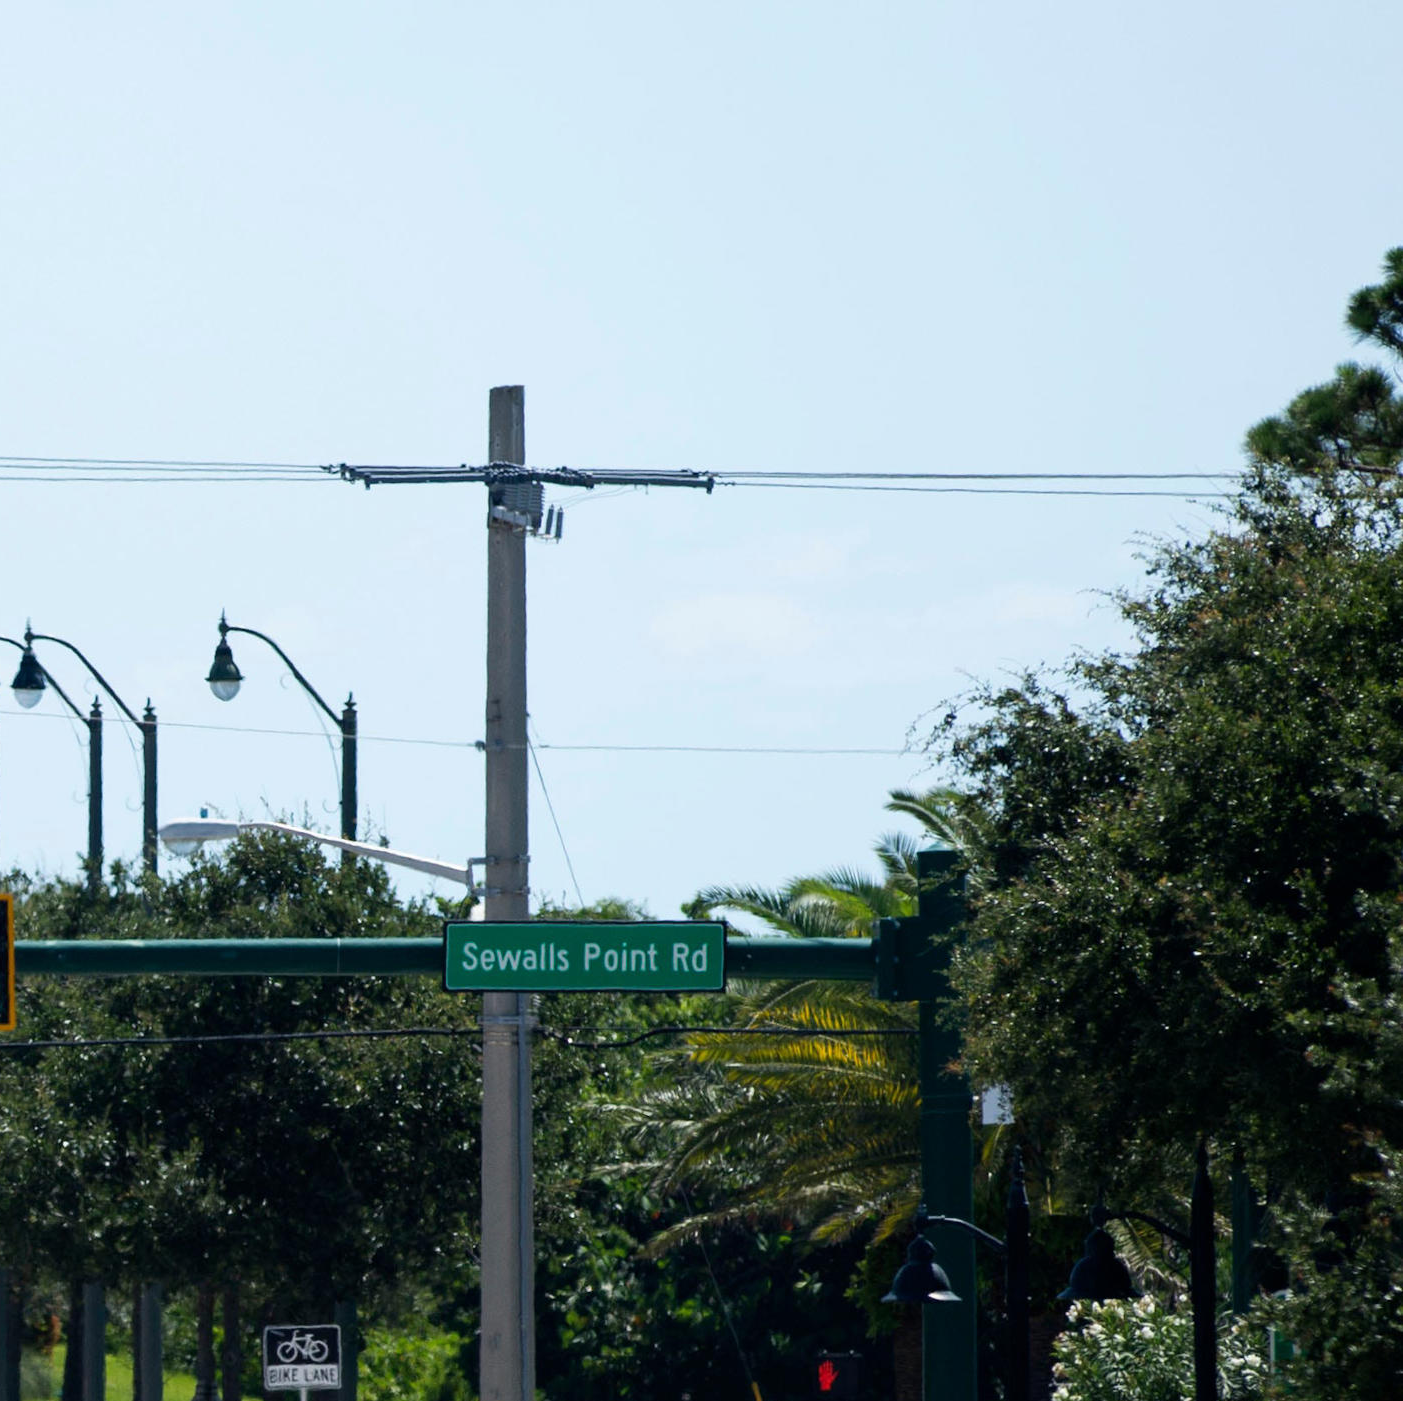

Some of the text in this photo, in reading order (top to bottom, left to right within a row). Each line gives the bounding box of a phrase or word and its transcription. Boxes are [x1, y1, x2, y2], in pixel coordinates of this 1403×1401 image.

[462, 942, 708, 973] Sewalls Point Rd
[269, 1367, 337, 1384] BIKE LANE
